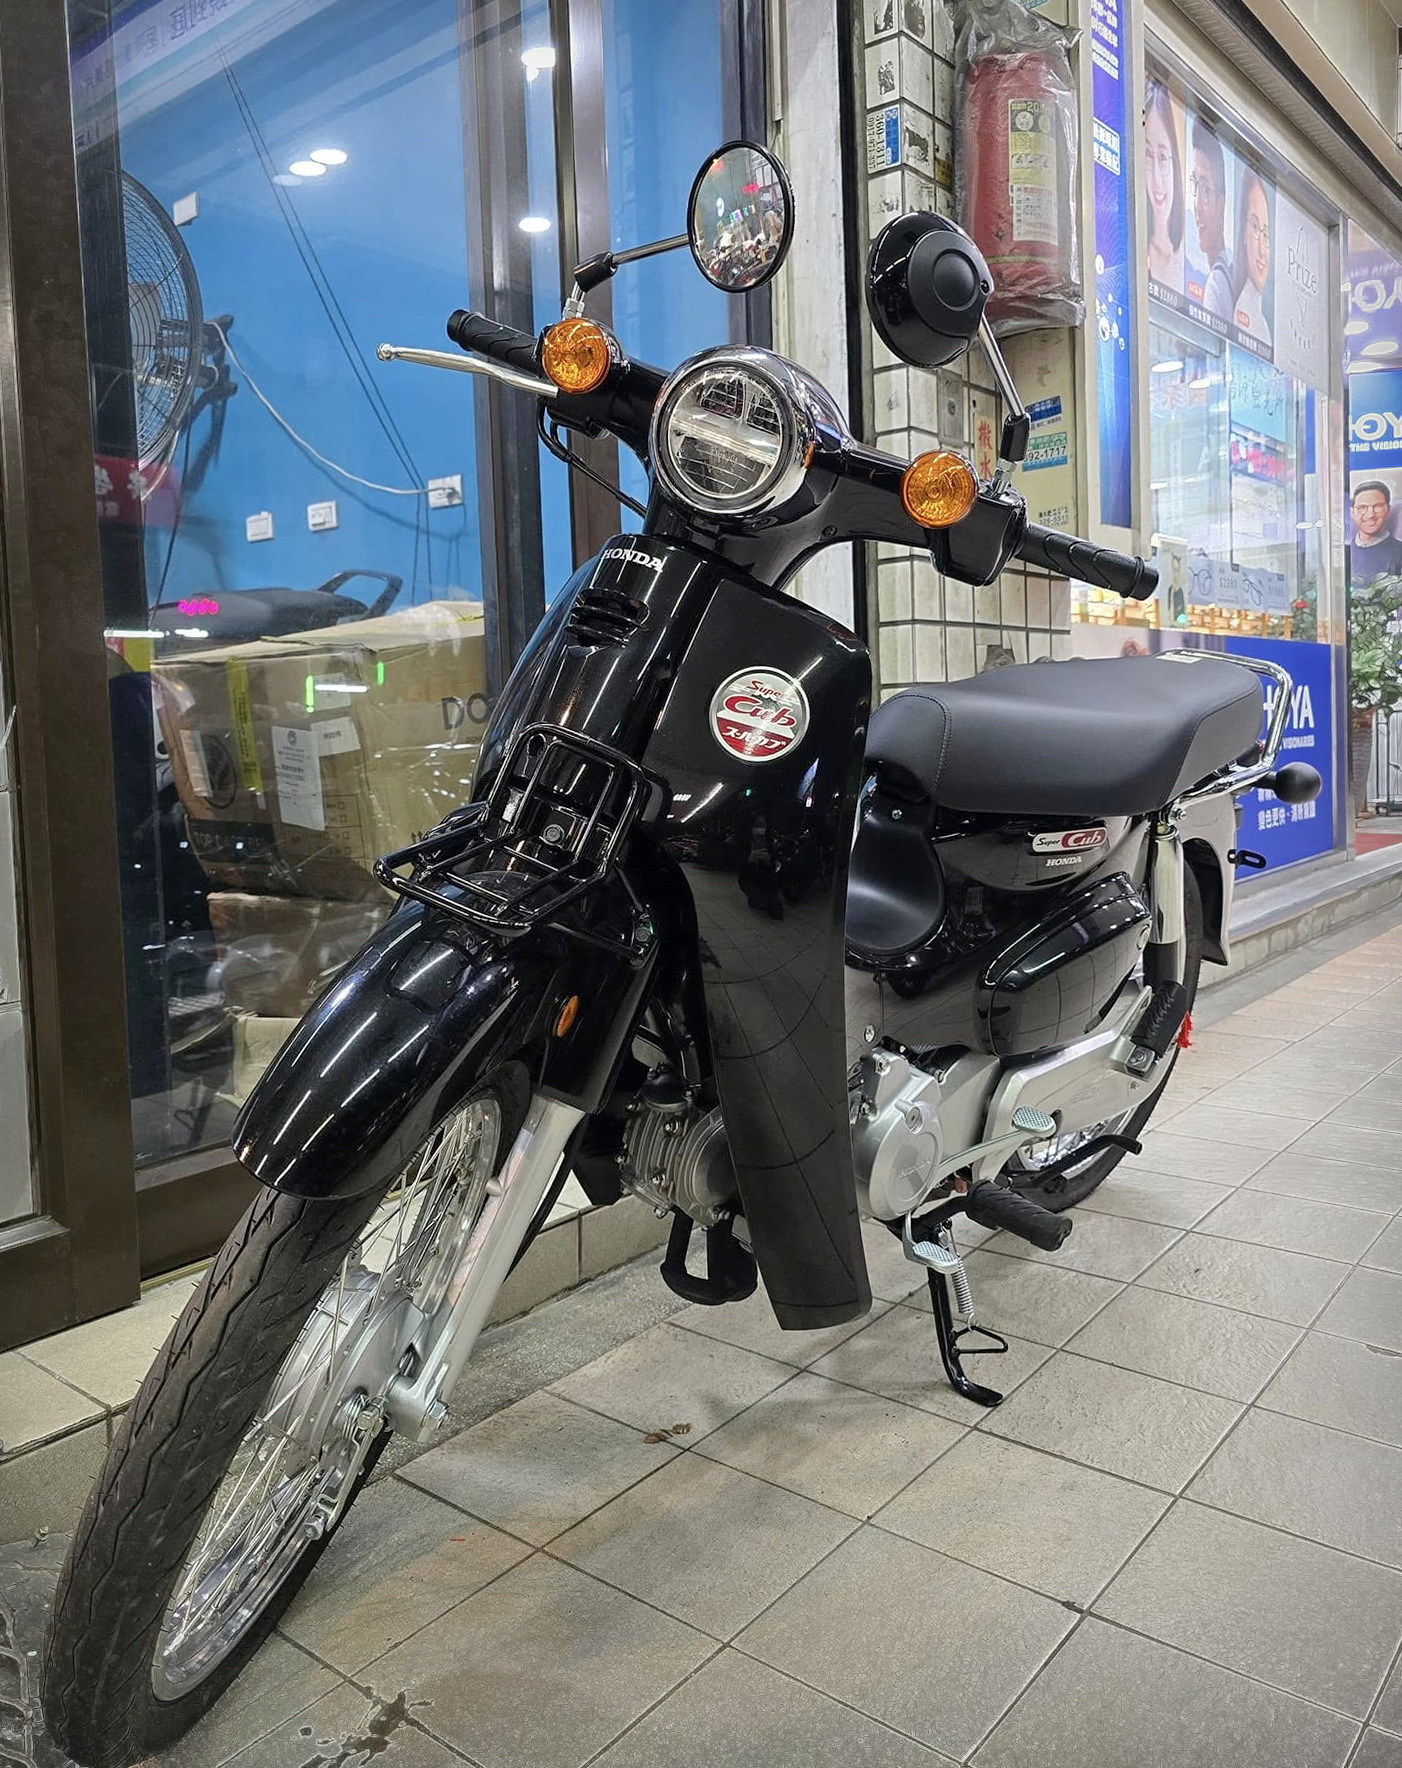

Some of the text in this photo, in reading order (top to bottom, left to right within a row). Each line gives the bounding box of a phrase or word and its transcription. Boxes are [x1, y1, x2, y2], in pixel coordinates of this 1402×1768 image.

[1287, 245, 1317, 294] Prize
[601, 547, 664, 573] HONDA
[723, 694, 797, 728] Cub
[1036, 830, 1101, 847] Super Cub
[1045, 856, 1082, 867] HONDA
